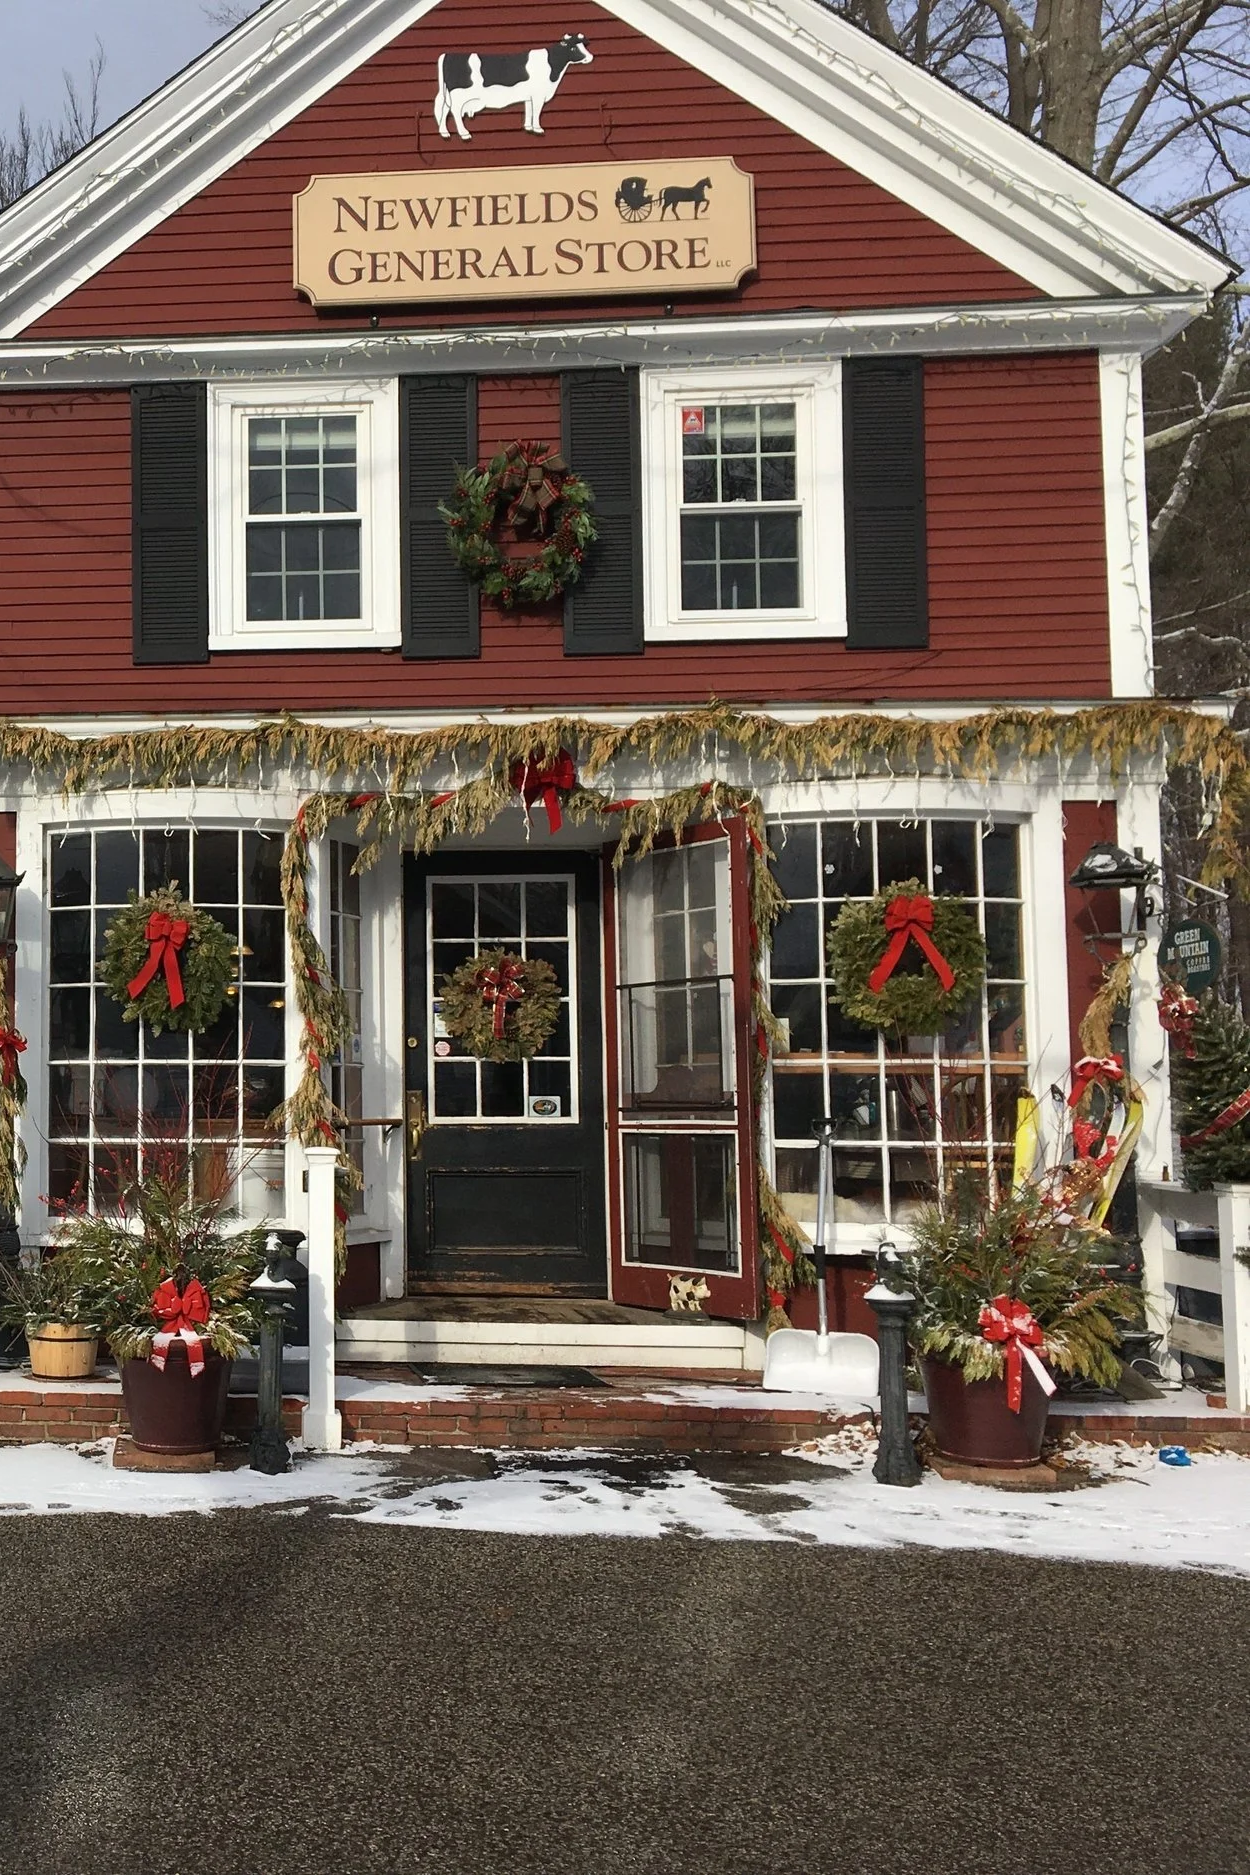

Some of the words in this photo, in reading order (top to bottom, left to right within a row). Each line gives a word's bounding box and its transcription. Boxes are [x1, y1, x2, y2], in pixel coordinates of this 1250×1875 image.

[332, 189, 599, 234] NEWFIELDS
[327, 245, 548, 286] GENERAL
[553, 236, 712, 275] STORE
[716, 259, 731, 268] LLC
[1167, 940, 1210, 961] MUNTAIN
[1174, 928, 1201, 945] GREEN
